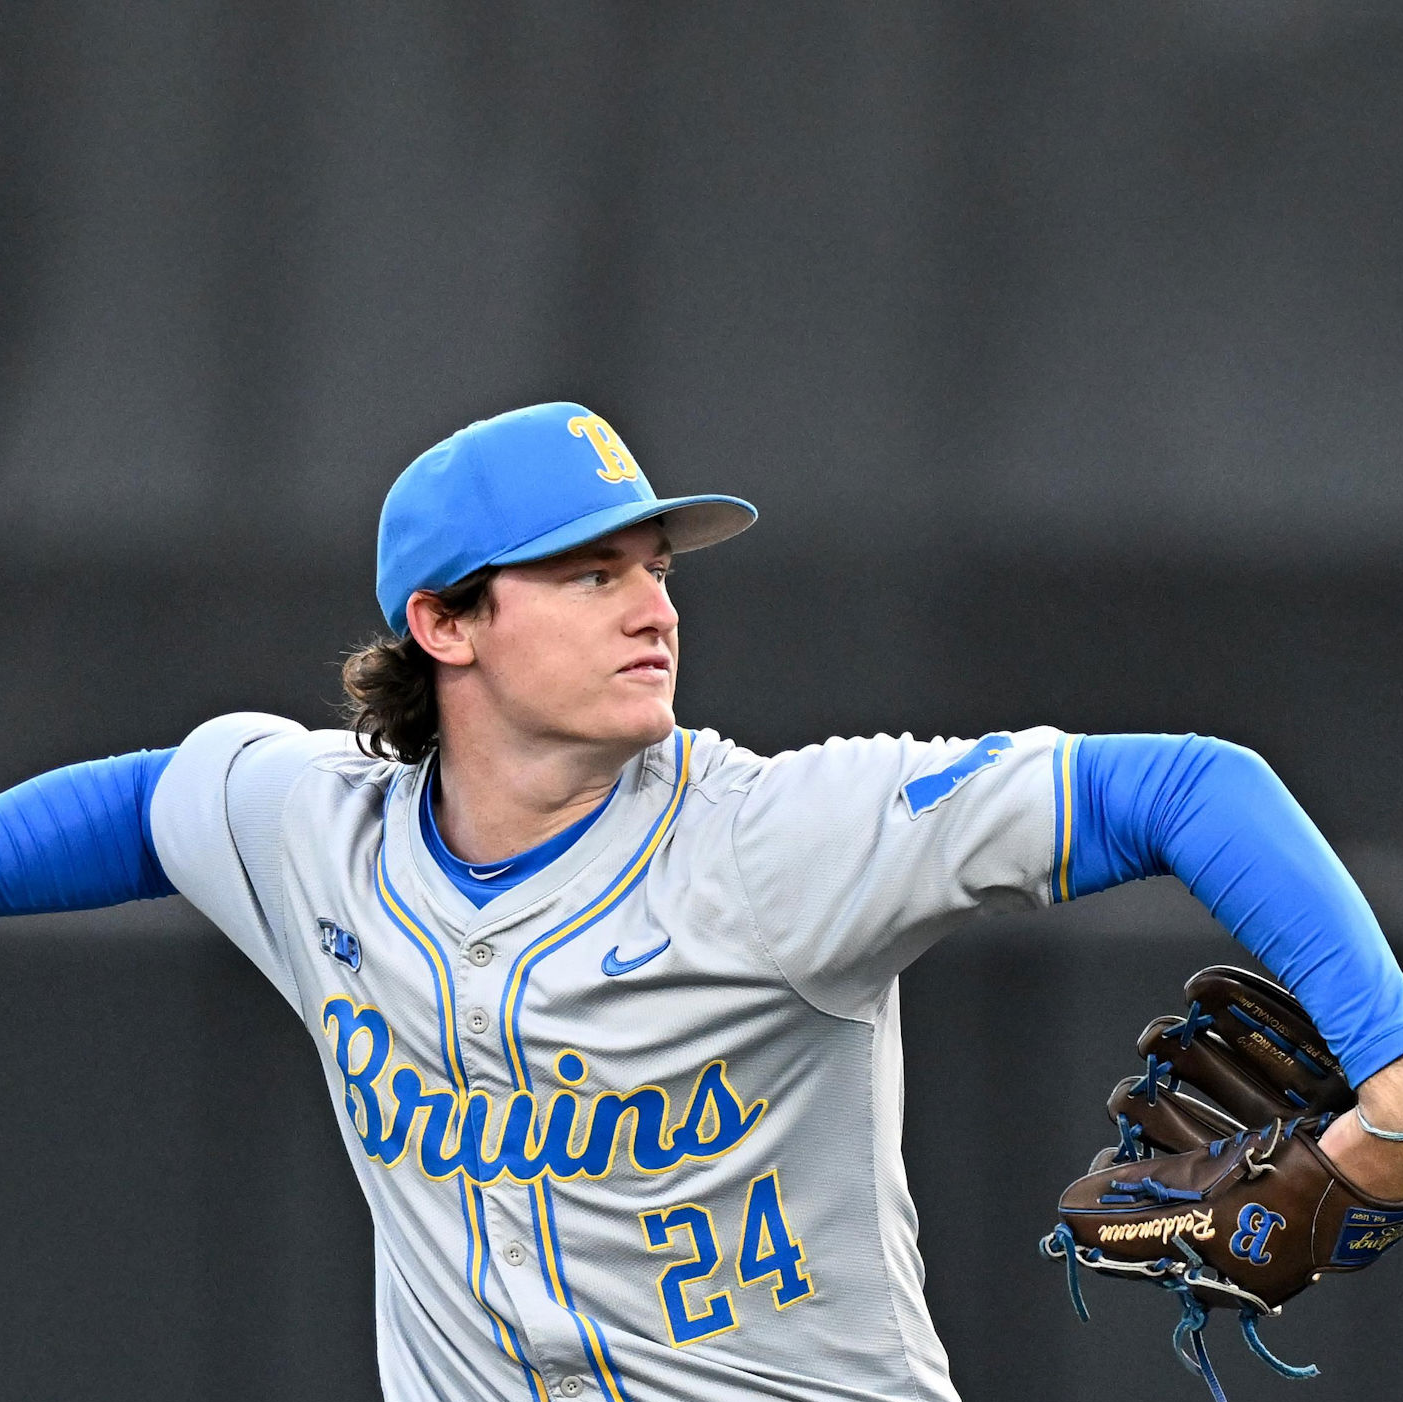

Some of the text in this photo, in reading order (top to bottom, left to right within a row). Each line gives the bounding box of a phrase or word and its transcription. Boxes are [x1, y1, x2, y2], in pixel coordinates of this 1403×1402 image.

[566, 414, 639, 484] B
[1249, 1031, 1271, 1050] INCH
[321, 992, 769, 1187] Bruins
[640, 1167, 815, 1350] 24
[1098, 1207, 1216, 1245] Reddemann
[1228, 1203, 1287, 1266] B
